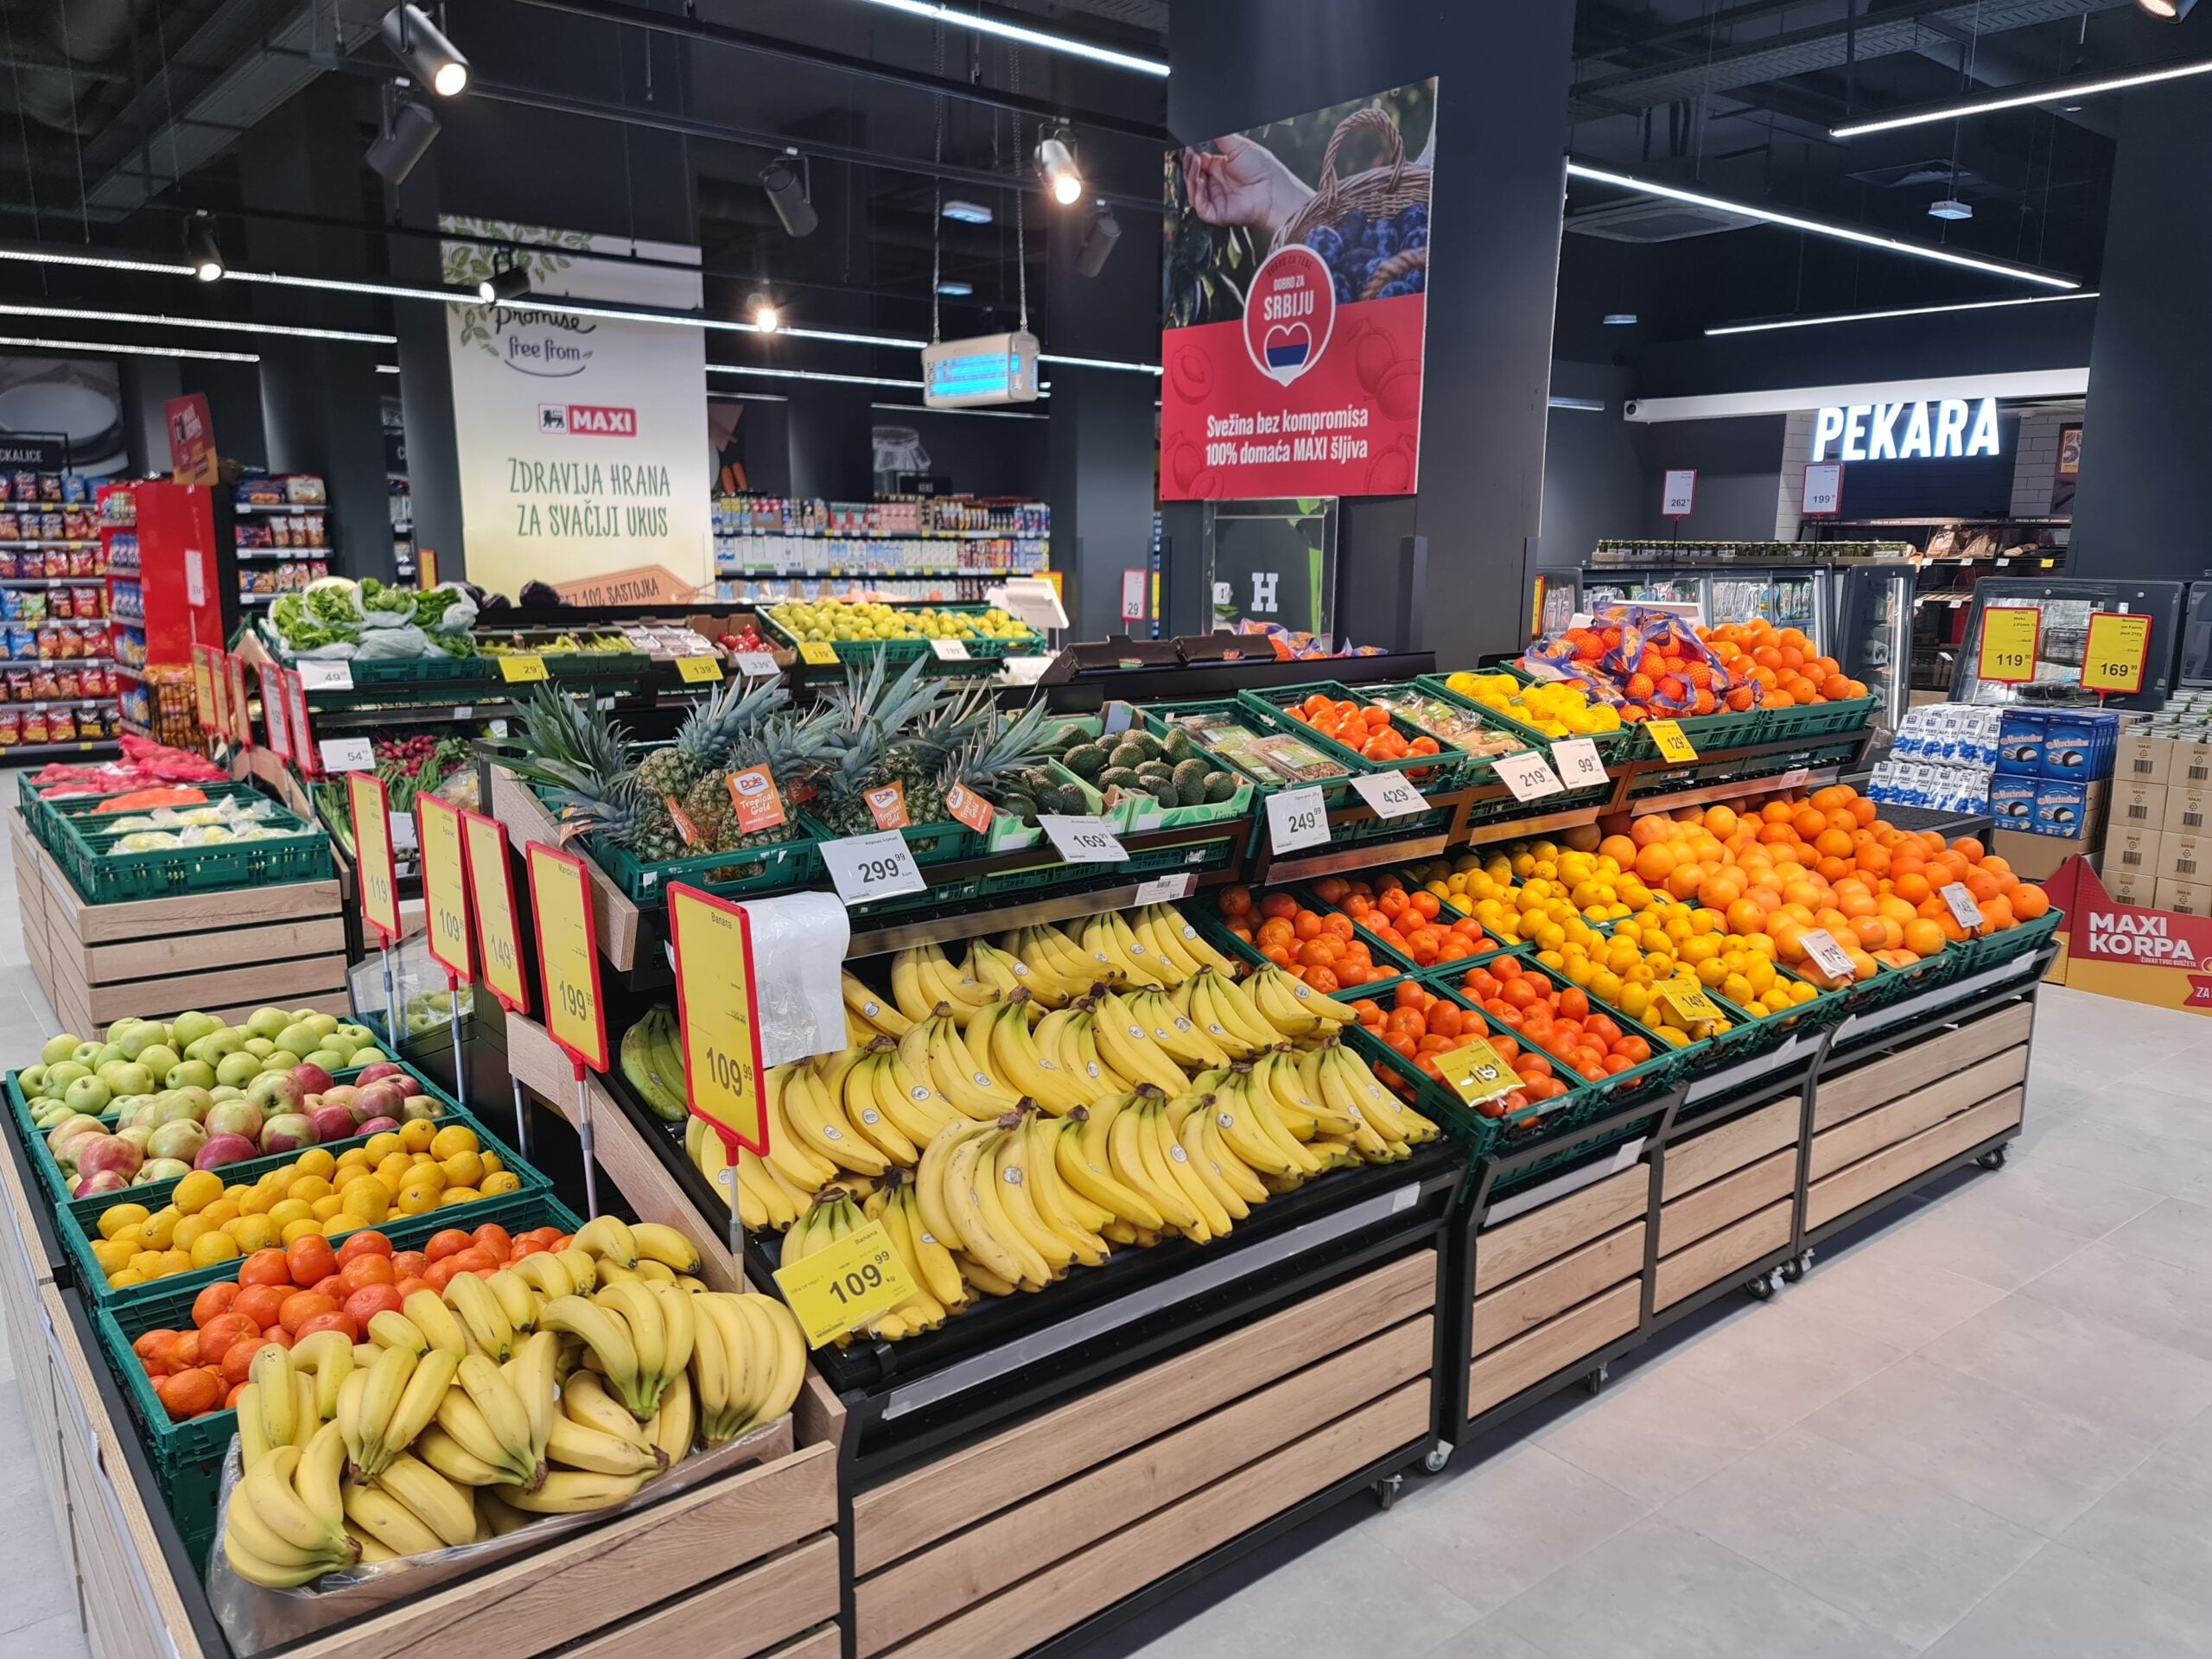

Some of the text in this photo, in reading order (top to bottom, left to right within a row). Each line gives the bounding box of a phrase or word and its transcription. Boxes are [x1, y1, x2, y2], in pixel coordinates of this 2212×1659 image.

[1296, 275, 1305, 288] ZA
[1264, 289, 1314, 321] SRBIJU
[510, 336, 581, 361] free from
[573, 410, 632, 432] MAXI
[1206, 404, 1369, 438] Svežina bez kompromisa
[1813, 397, 1999, 462] PEKARA
[1205, 435, 1368, 466] 100% domaća MAXI šljiva
[508, 458, 671, 497] ZDRAVIJA HRANA
[1671, 499, 1686, 507] 262
[1813, 495, 1830, 504] 199
[517, 499, 669, 537] ZA SVAČIJI UKUS
[607, 577, 659, 605] SASTOJKA
[1251, 572, 1279, 613] H
[1128, 602, 1139, 616] 29
[523, 665, 537, 674] 29
[693, 665, 711, 675] 139
[1997, 654, 2023, 666] 119
[2101, 663, 2128, 677] 169
[1667, 736, 1685, 749] 129
[347, 752, 363, 761] 54
[1578, 758, 1593, 772] 99
[741, 777, 762, 789] Dole
[1520, 770, 1546, 787] 219
[740, 789, 775, 810] Tropical
[874, 790, 894, 803] Dole
[960, 792, 973, 819] Tropical
[1382, 789, 1409, 804] 429
[751, 801, 771, 816] Gold
[879, 802, 902, 823] Tropical
[969, 801, 980, 819] Gold
[887, 815, 901, 827] Gold
[1289, 812, 1315, 833] 249
[1073, 835, 1106, 848] 169
[858, 858, 899, 883] 299
[894, 853, 906, 861] 99
[370, 874, 387, 903] 119
[440, 907, 460, 942] 109
[711, 912, 732, 929] Banana
[2089, 912, 2167, 937] MAXI
[492, 934, 512, 969] 149
[2089, 933, 2196, 960] KORPA
[560, 980, 593, 1021] 199 99
[2197, 987, 2209, 998] ZA
[706, 1046, 753, 1097] 109 99
[855, 1230, 878, 1245] Banana
[830, 1263, 882, 1304] 109
[874, 1250, 890, 1265] 99
